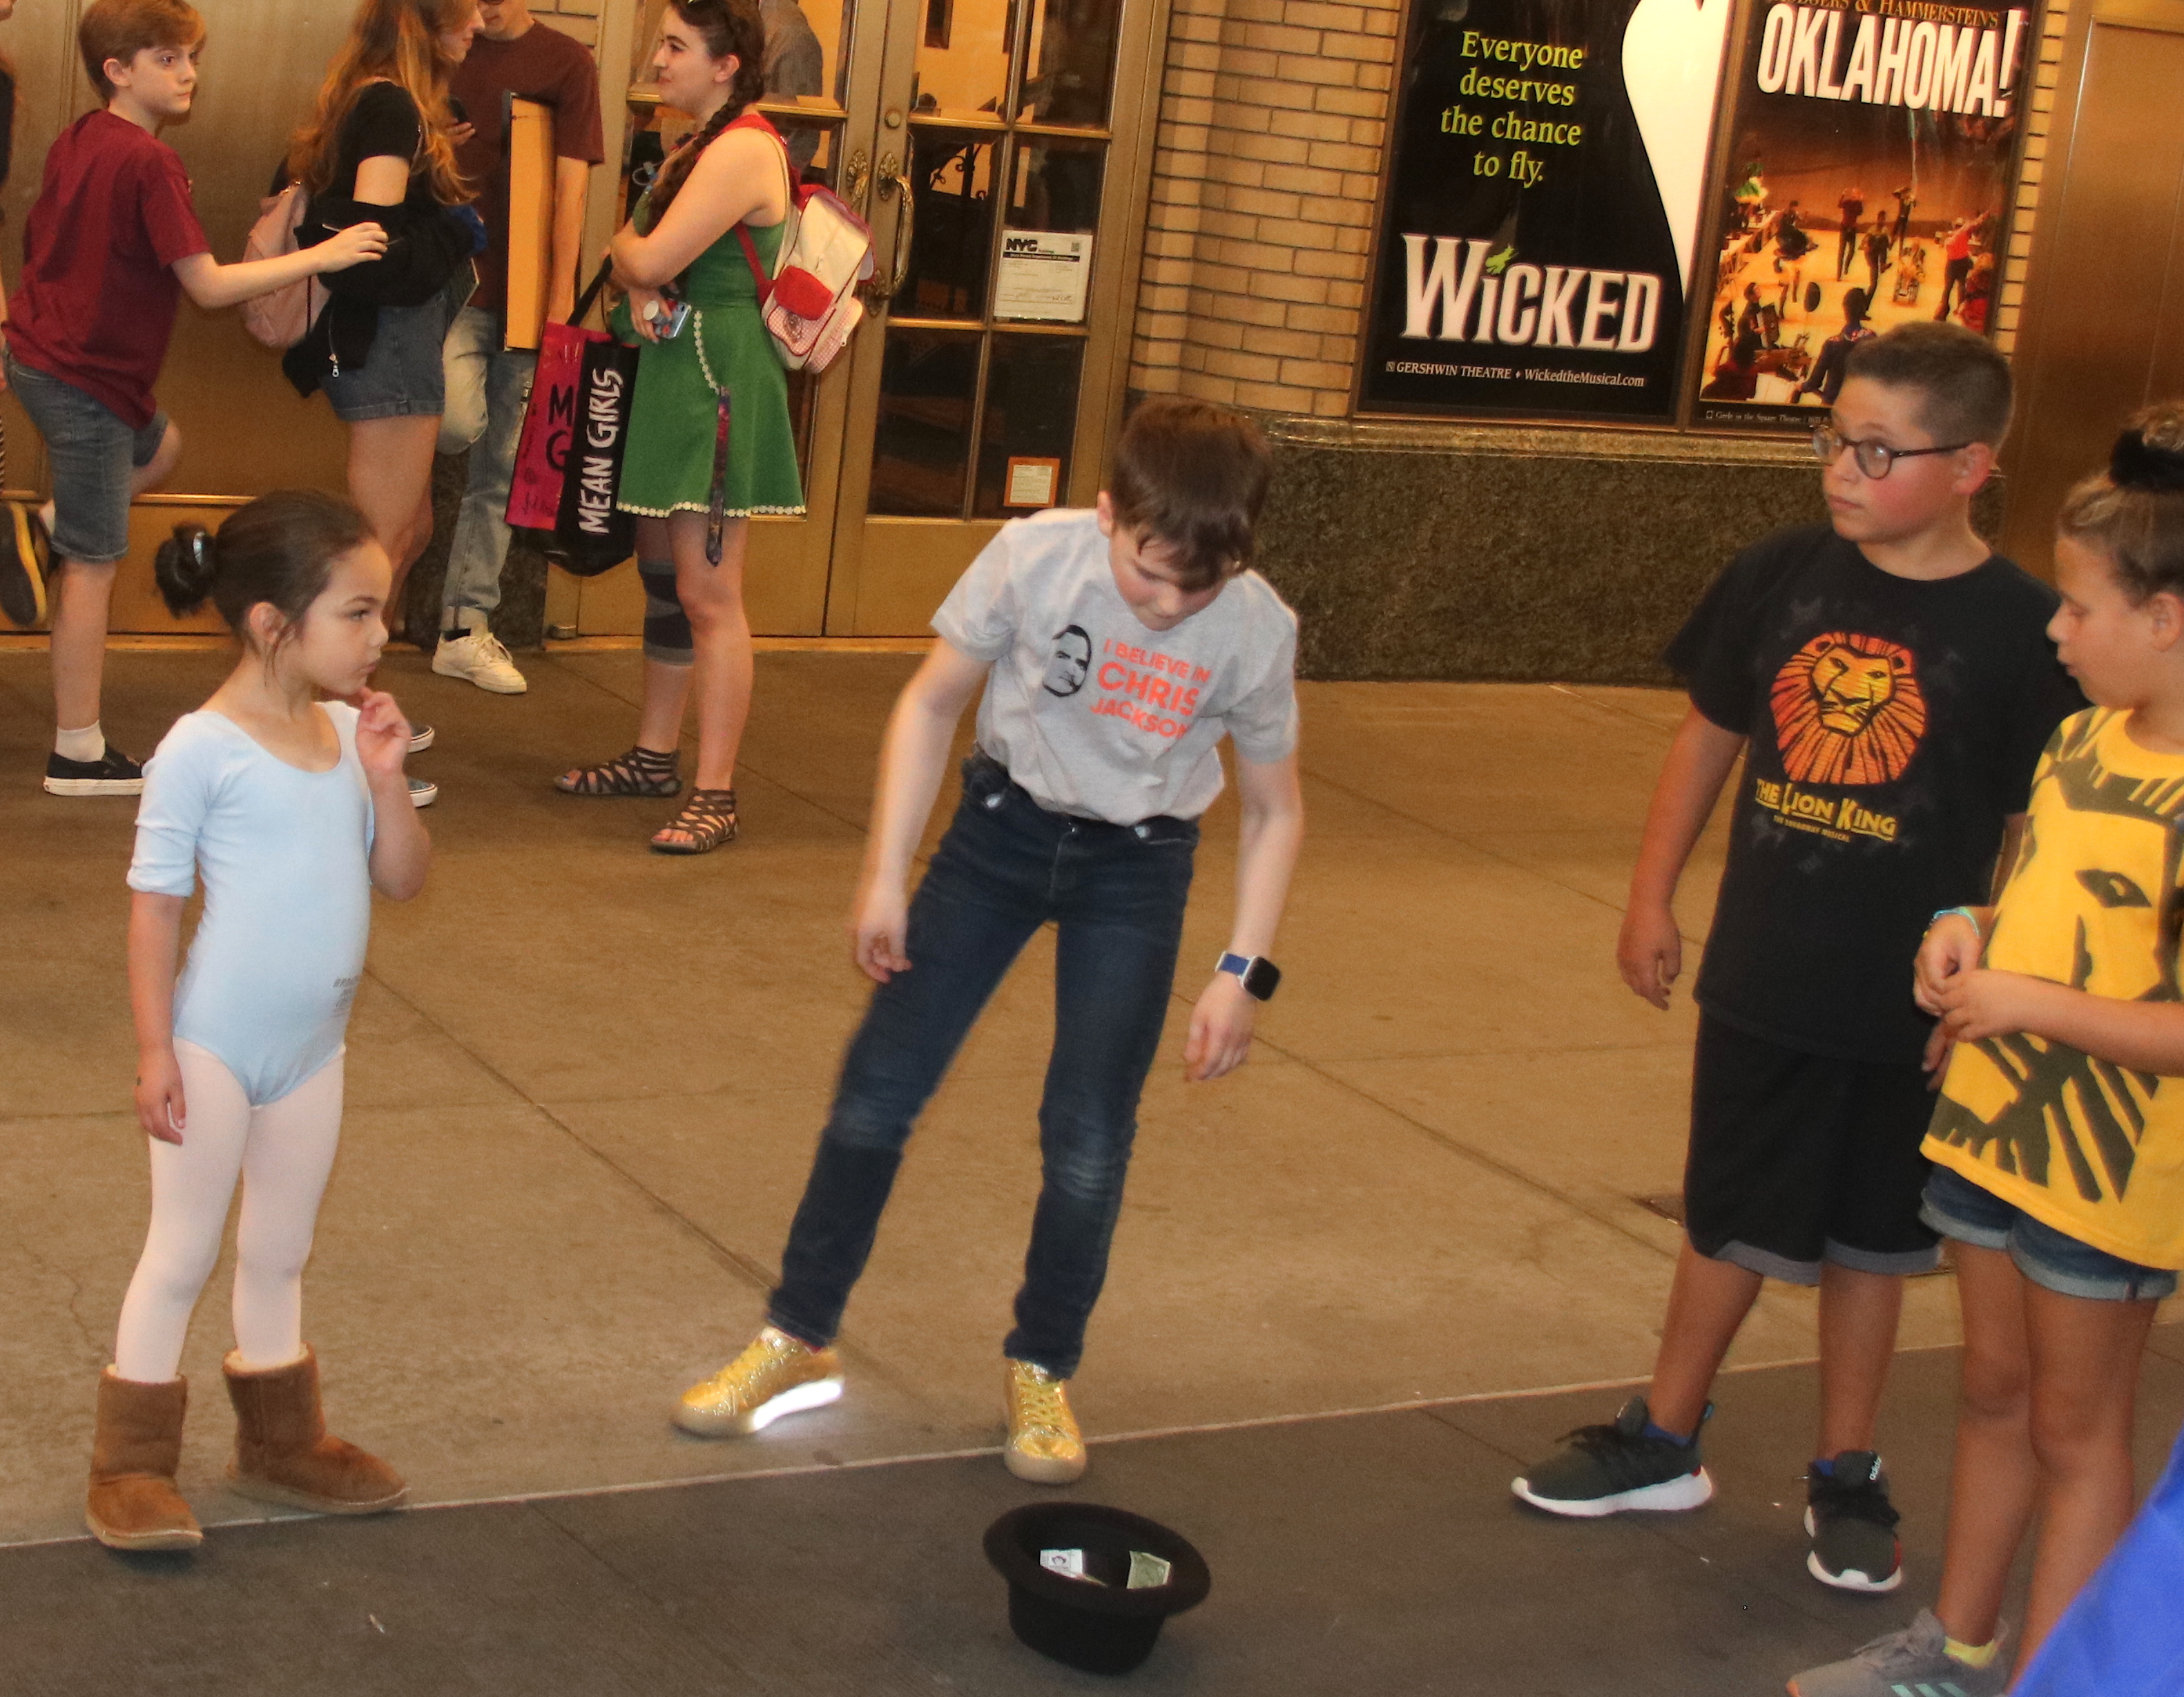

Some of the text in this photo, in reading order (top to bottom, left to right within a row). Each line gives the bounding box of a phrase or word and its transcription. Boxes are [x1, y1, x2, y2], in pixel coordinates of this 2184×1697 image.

[1879, 0, 1999, 28] HAMMERSTEIN'S
[1460, 30, 1583, 71] Everyone
[1757, 2, 2022, 118] OKLAHOMA!
[1459, 67, 1575, 106] deserves
[1440, 105, 1583, 146] the chance
[1473, 150, 1545, 189] to fly.
[1005, 238, 1038, 252] NYC
[1396, 361, 1645, 387] GERSHWIN THEATRE WickedtheMusical.com
[578, 367, 625, 535] MEAN GIRLS
[1103, 638, 1212, 683] I BELIEVE IN
[1097, 661, 1200, 717] CHRIS
[1089, 697, 1190, 740] JACKSON
[1755, 778, 1781, 807] THE
[1835, 797, 1897, 836] KING
